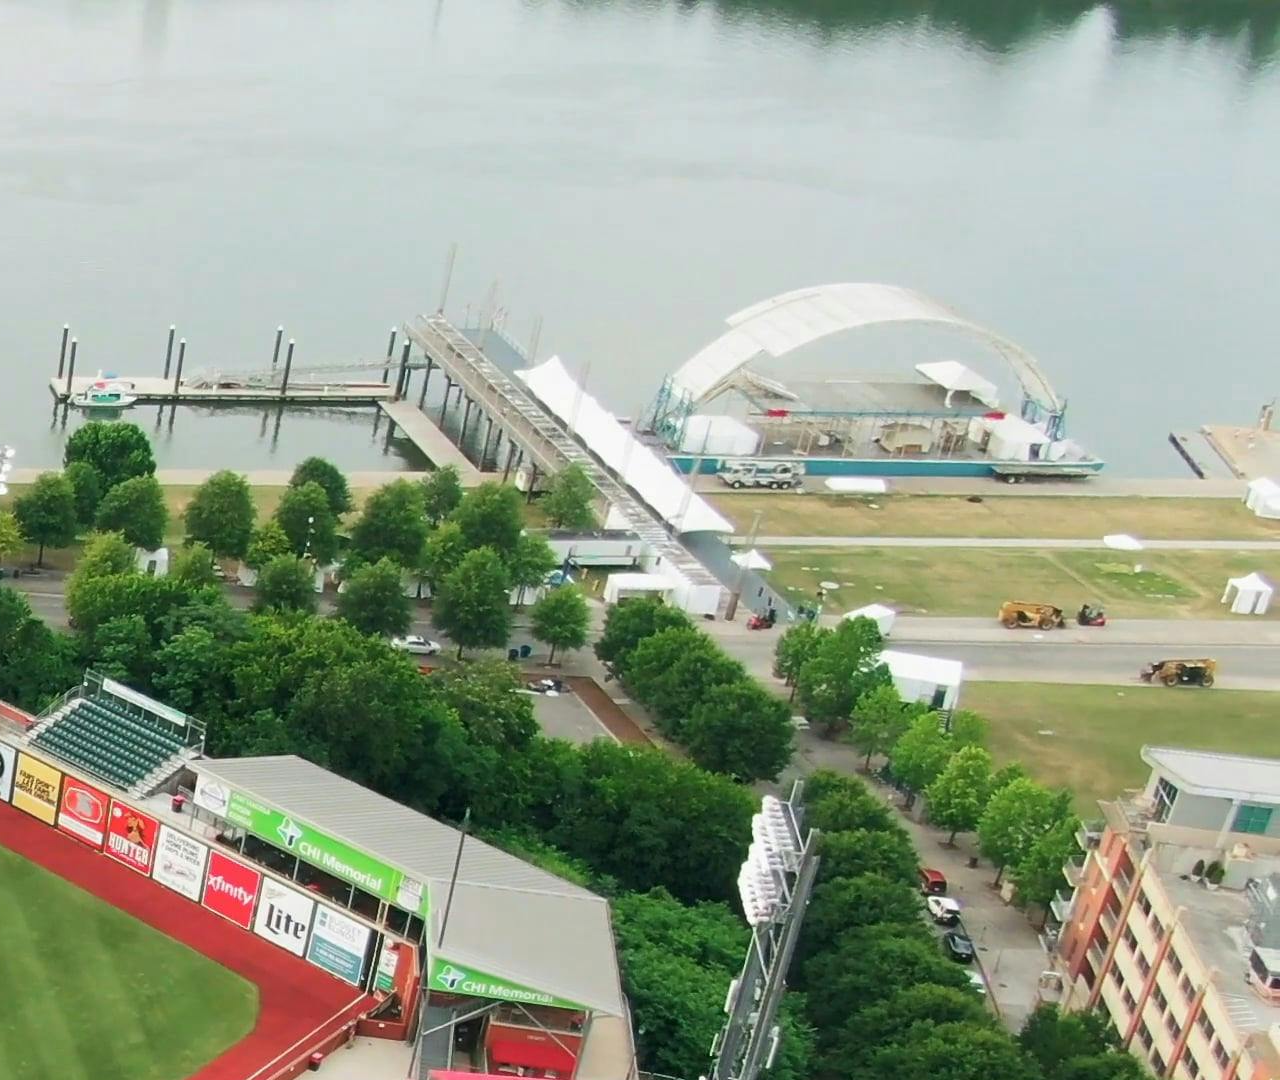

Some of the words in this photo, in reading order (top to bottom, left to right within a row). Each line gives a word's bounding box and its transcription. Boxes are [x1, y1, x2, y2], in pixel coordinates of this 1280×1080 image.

[109, 831, 150, 866] HUNTER
[298, 841, 321, 861] CHI
[322, 853, 384, 891] Memorial
[207, 873, 254, 906] xfinity
[265, 903, 306, 939] Lite
[462, 981, 487, 994] CHI
[488, 984, 554, 1003] Memorial
